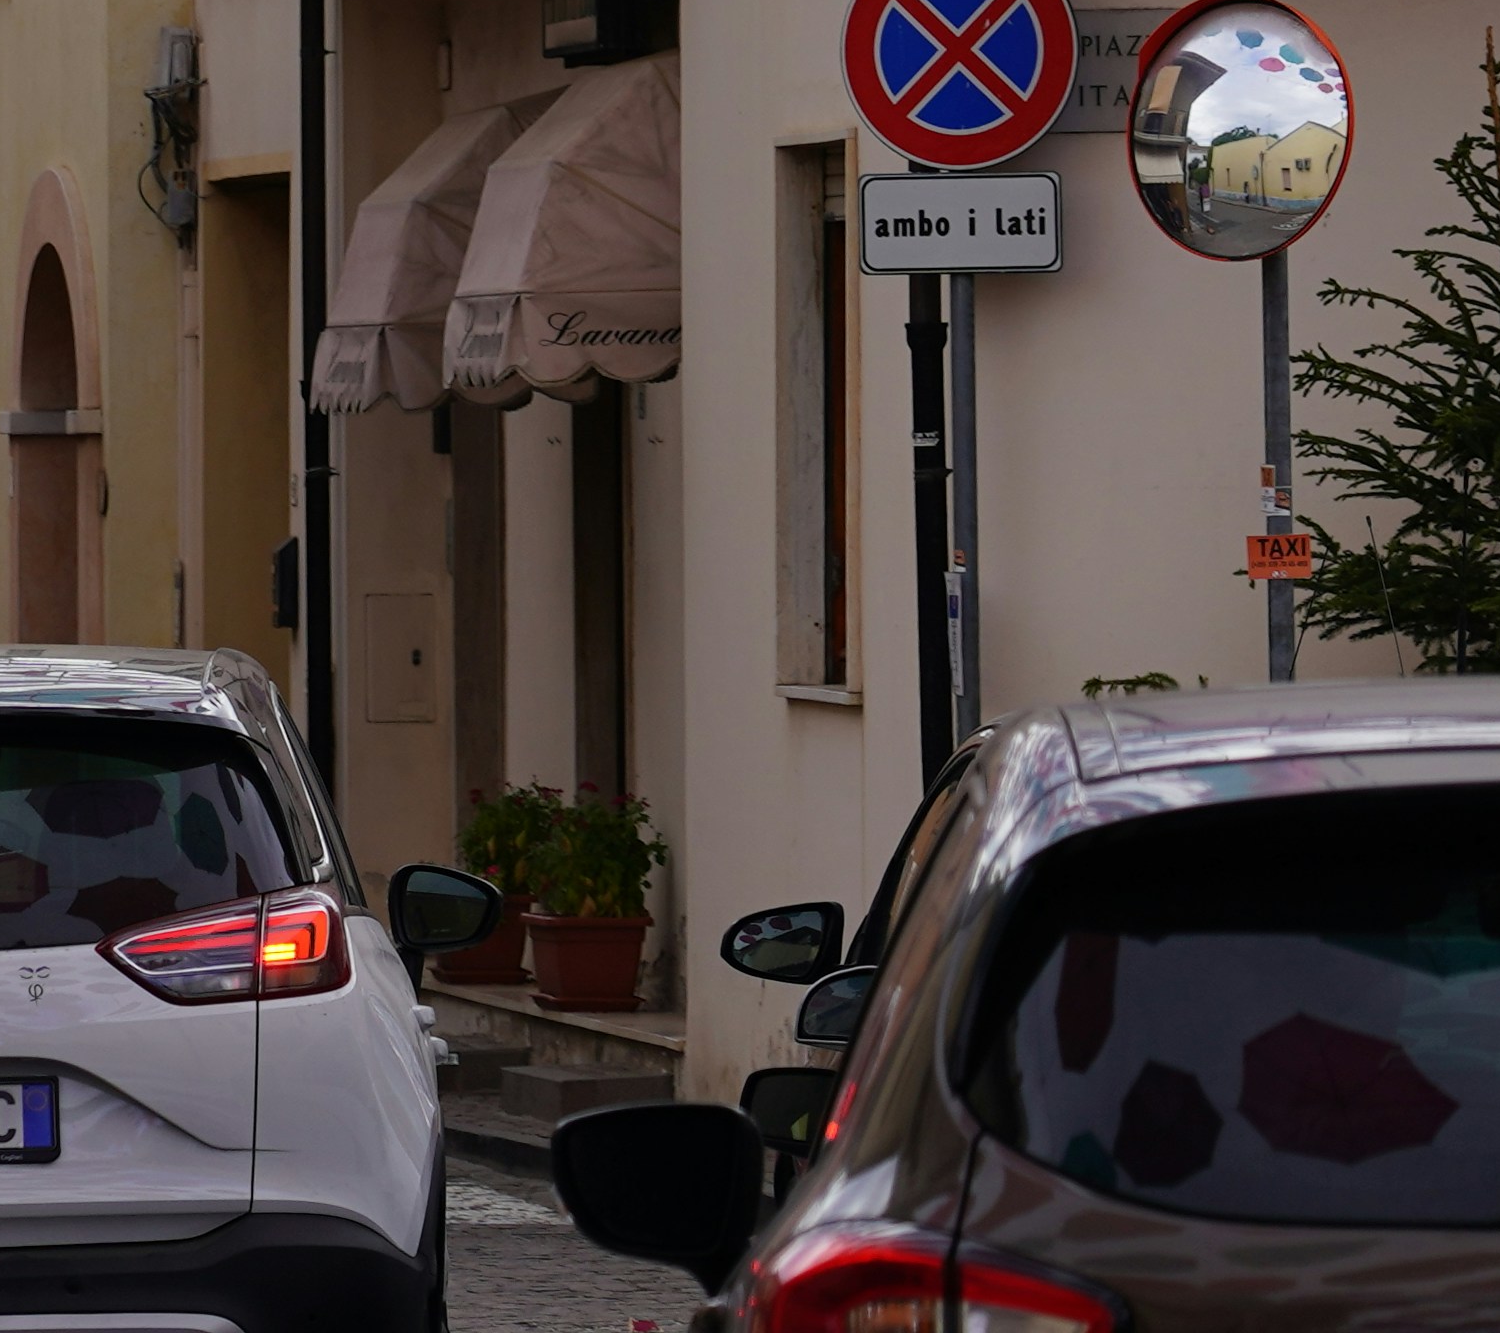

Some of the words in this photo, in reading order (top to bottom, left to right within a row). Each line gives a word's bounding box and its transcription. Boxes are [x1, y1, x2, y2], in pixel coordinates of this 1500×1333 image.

[1080, 35, 1149, 57] PIAZ
[1079, 85, 1129, 107] ITA
[874, 209, 950, 238] ambo
[968, 208, 977, 236] i
[995, 207, 1047, 236] lati
[538, 311, 681, 347] Lavand
[1256, 537, 1306, 559] TAXI
